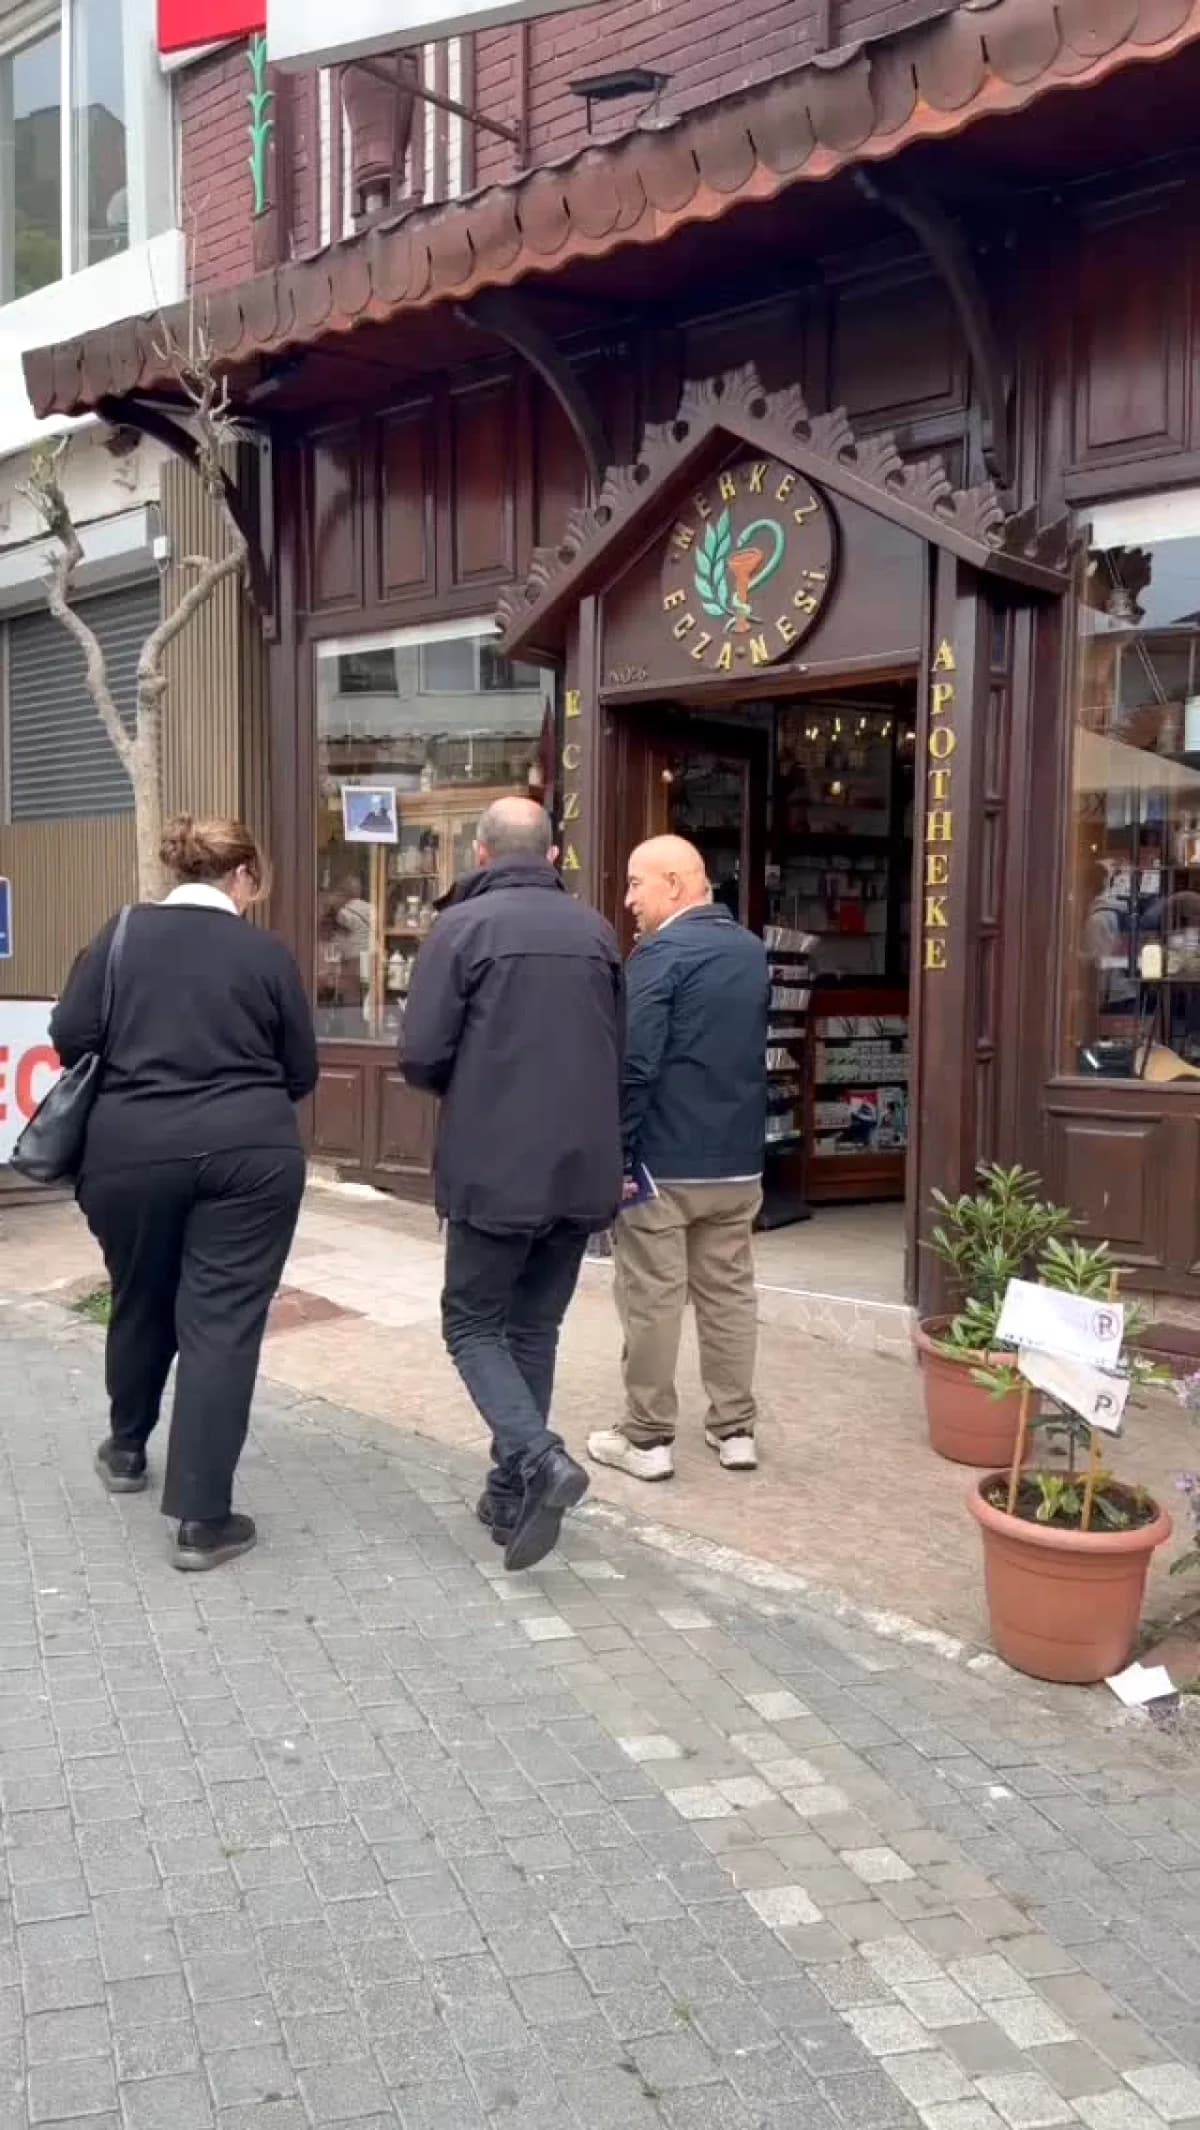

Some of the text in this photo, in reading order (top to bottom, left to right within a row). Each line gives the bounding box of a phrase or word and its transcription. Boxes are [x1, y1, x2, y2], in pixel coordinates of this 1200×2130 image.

[671, 464, 820, 550] MERKEZ
[562, 689, 583, 898] ECZA
[924, 639, 956, 969] APOTHEKE
